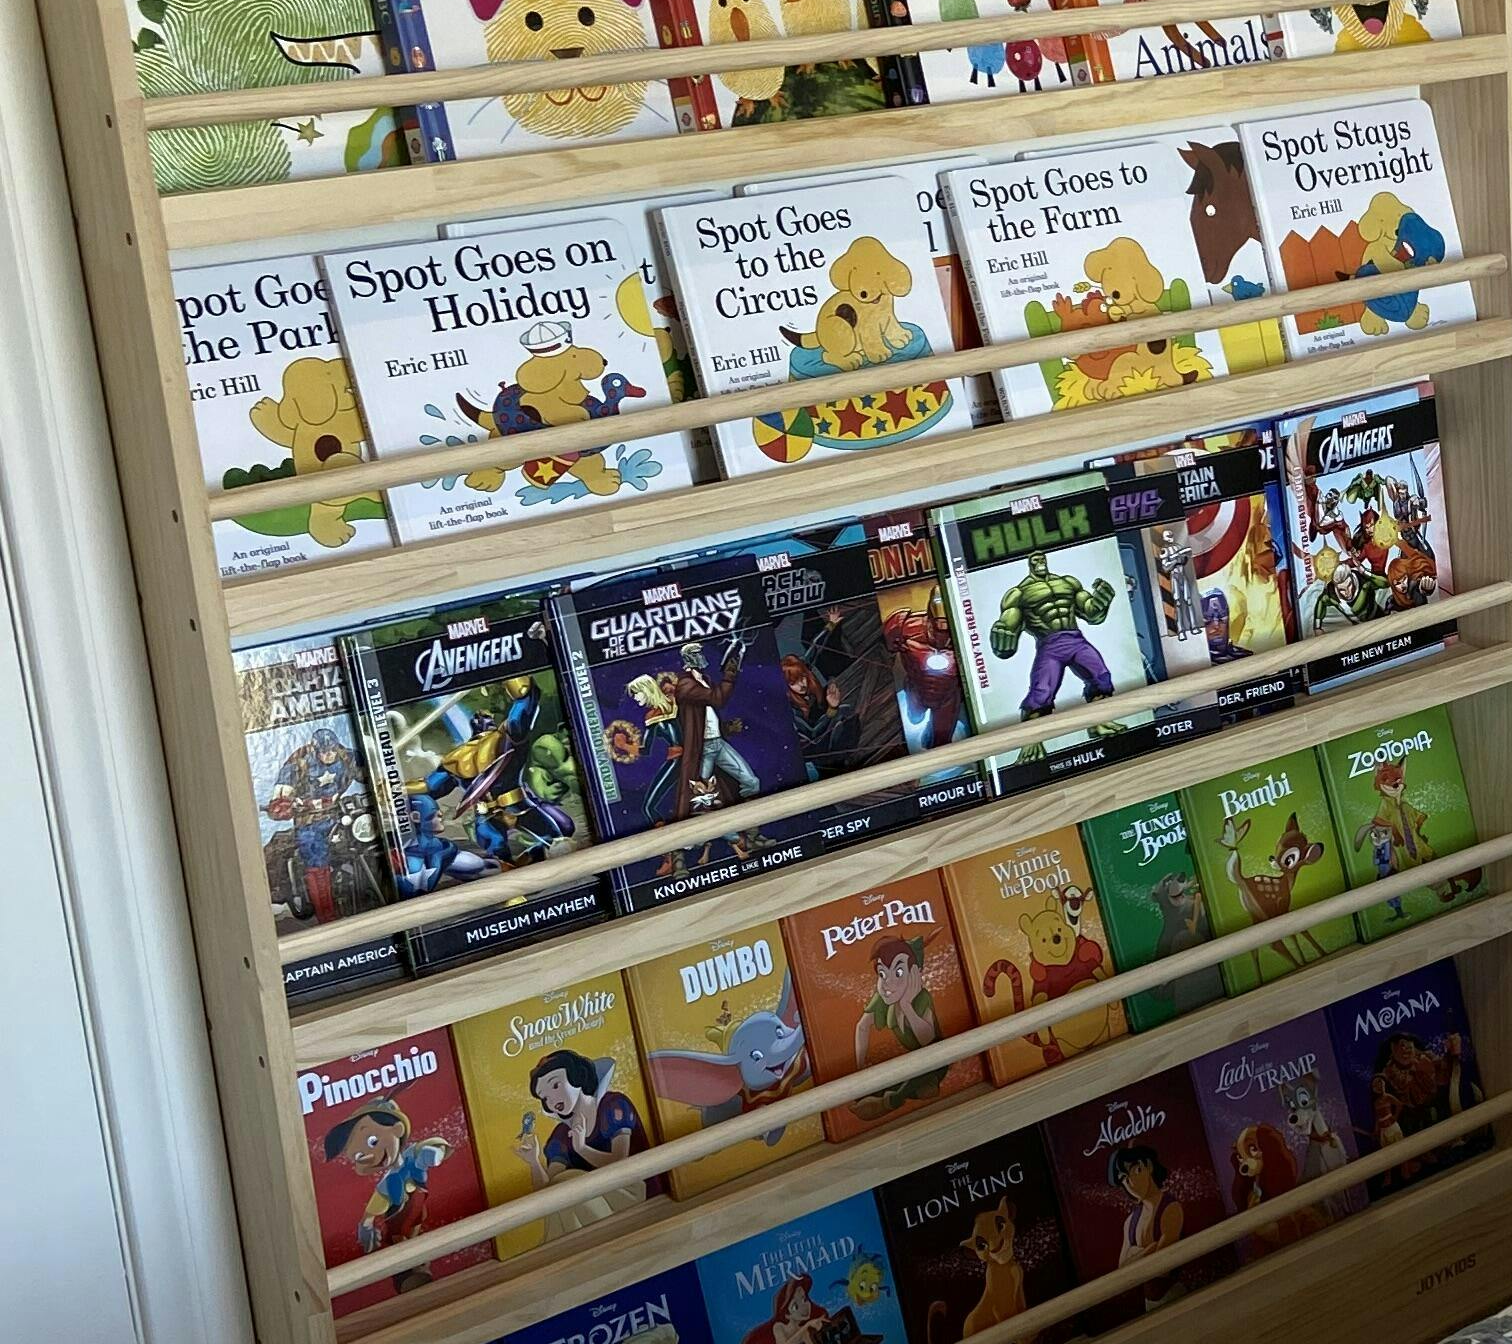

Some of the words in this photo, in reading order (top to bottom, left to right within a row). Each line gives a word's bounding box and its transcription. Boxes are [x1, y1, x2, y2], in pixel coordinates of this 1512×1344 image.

[1262, 128, 1328, 166] Spot
[1333, 120, 1411, 150] Stays
[969, 175, 1039, 211] Spot
[1044, 168, 1115, 197] Goes
[1119, 162, 1148, 185] to
[1295, 146, 1433, 192] Overnight
[987, 214, 1037, 243] the
[1040, 203, 1123, 235] Farm
[1290, 204, 1318, 221] Eric
[1318, 199, 1343, 215] Hill
[696, 213, 771, 253] Spot
[776, 205, 852, 237] Goes
[346, 256, 447, 304] Spot
[455, 245, 556, 282] Goes
[566, 239, 617, 267] on
[735, 253, 769, 279] to
[774, 242, 826, 275] the
[986, 255, 1018, 274] Eric
[1020, 250, 1049, 270] Hill
[1007, 277, 1019, 286] An
[1019, 272, 1048, 285] original
[175, 284, 246, 328] pot
[255, 274, 328, 308] Goe
[424, 283, 592, 333] Holiday
[715, 283, 818, 319] Circus
[385, 356, 428, 378] Eric
[430, 349, 469, 371] Hill
[711, 353, 747, 372] Eric
[749, 345, 782, 366] Hill
[190, 383, 216, 401] ric
[220, 374, 261, 396] Hill
[729, 376, 741, 385] An
[1342, 410, 1368, 428] MARVEL
[1318, 424, 1394, 474] AVENGERS
[1178, 466, 1215, 485] TAIN
[429, 512, 485, 531] lift-the-flap
[486, 509, 509, 521] book
[439, 505, 455, 516] An
[457, 497, 493, 514] original
[1009, 495, 1042, 516] MARVEL
[878, 522, 914, 543] MARVEL
[972, 504, 1091, 563] HULK
[232, 550, 248, 561] An
[250, 542, 290, 559] original
[283, 553, 308, 565] book
[756, 552, 792, 572] MARVEL
[642, 583, 681, 605] MARVEL
[447, 616, 489, 641] MARVEL
[590, 588, 743, 640] GUARDIANS
[626, 608, 742, 654] GALAXY
[295, 645, 337, 668] MARVEL
[571, 649, 584, 661] 2
[602, 643, 627, 660] THE
[609, 634, 626, 649] OF
[1341, 654, 1361, 667] THE
[1362, 645, 1384, 661] NEW
[1385, 636, 1412, 654] TEAM
[415, 631, 524, 692] AVENGERS
[271, 665, 342, 696] CAPTA
[366, 678, 379, 690] 3
[576, 662, 593, 699] LEVEL
[1246, 681, 1285, 699] FRIEND
[270, 687, 345, 721] AMER
[369, 690, 387, 730] LEVEL
[1072, 748, 1105, 768] HULK
[1348, 730, 1433, 779] ZOOTOPIA
[919, 786, 965, 808] RMOUR
[1218, 772, 1294, 820] Bambi
[847, 817, 871, 834] SPY
[1123, 809, 1182, 854] JUNGL
[654, 864, 739, 900] KNOWHERE
[742, 860, 760, 873] LIKE
[762, 845, 803, 869] HOME
[990, 848, 1061, 883] Winnie
[1000, 882, 1021, 899] the
[1019, 865, 1071, 898] Pooh
[466, 914, 531, 945] MUSEUM
[534, 894, 596, 921] MAYHEM
[820, 910, 885, 960] Peter
[883, 899, 936, 928] Pan
[284, 961, 334, 985] APTAIN
[338, 945, 398, 971] AMERICA
[679, 939, 774, 1004] DUMBO
[503, 1011, 563, 1057] Snow
[559, 990, 616, 1026] White
[1355, 990, 1440, 1041] MOANA
[298, 1046, 438, 1115] Pinocchio
[1215, 1056, 1255, 1100] Lady
[1254, 1053, 1316, 1093] TRAMP
[1083, 1105, 1168, 1157] Aladdin
[903, 1190, 961, 1229] LION
[968, 1162, 1025, 1202] KING
[950, 1173, 972, 1192] THE
[735, 1236, 855, 1299] MERMAID
[1416, 1254, 1478, 1296] JOYKIDS
